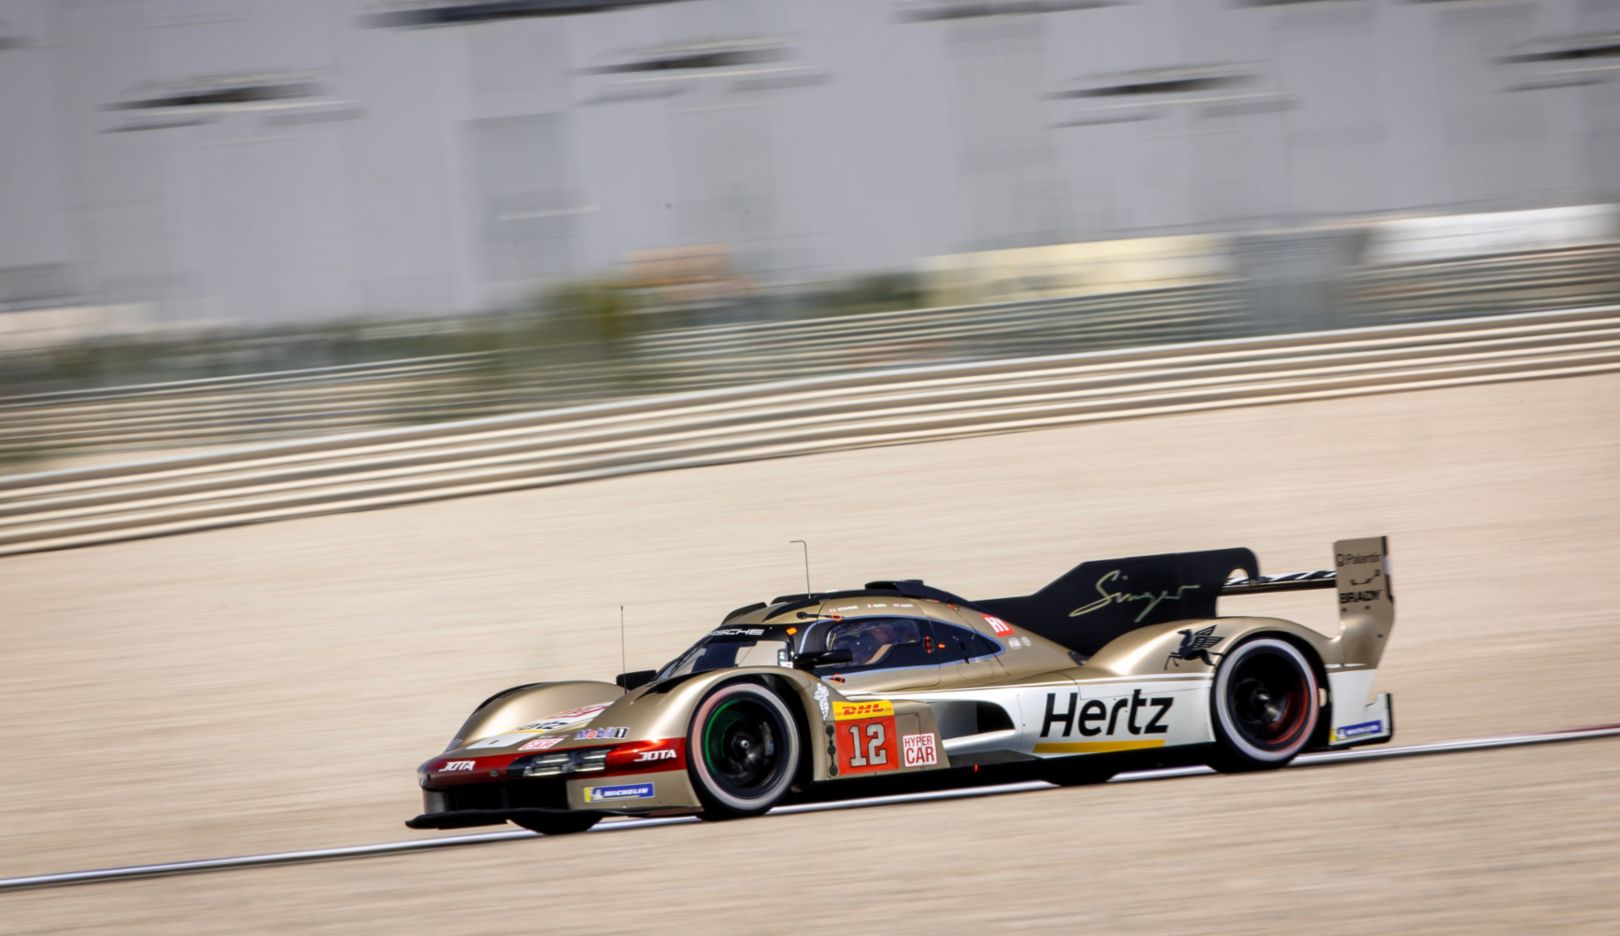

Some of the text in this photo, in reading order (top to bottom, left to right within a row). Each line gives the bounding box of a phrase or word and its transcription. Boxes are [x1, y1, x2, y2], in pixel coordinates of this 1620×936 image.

[842, 703, 884, 716] DHL
[1040, 689, 1174, 738] Hertz
[849, 722, 887, 768] 12
[904, 735, 933, 748] HYPER
[633, 749, 677, 762] JOTA
[905, 746, 935, 765] CAR
[438, 760, 476, 772] JOTA
[603, 787, 649, 796] MICHELIN
